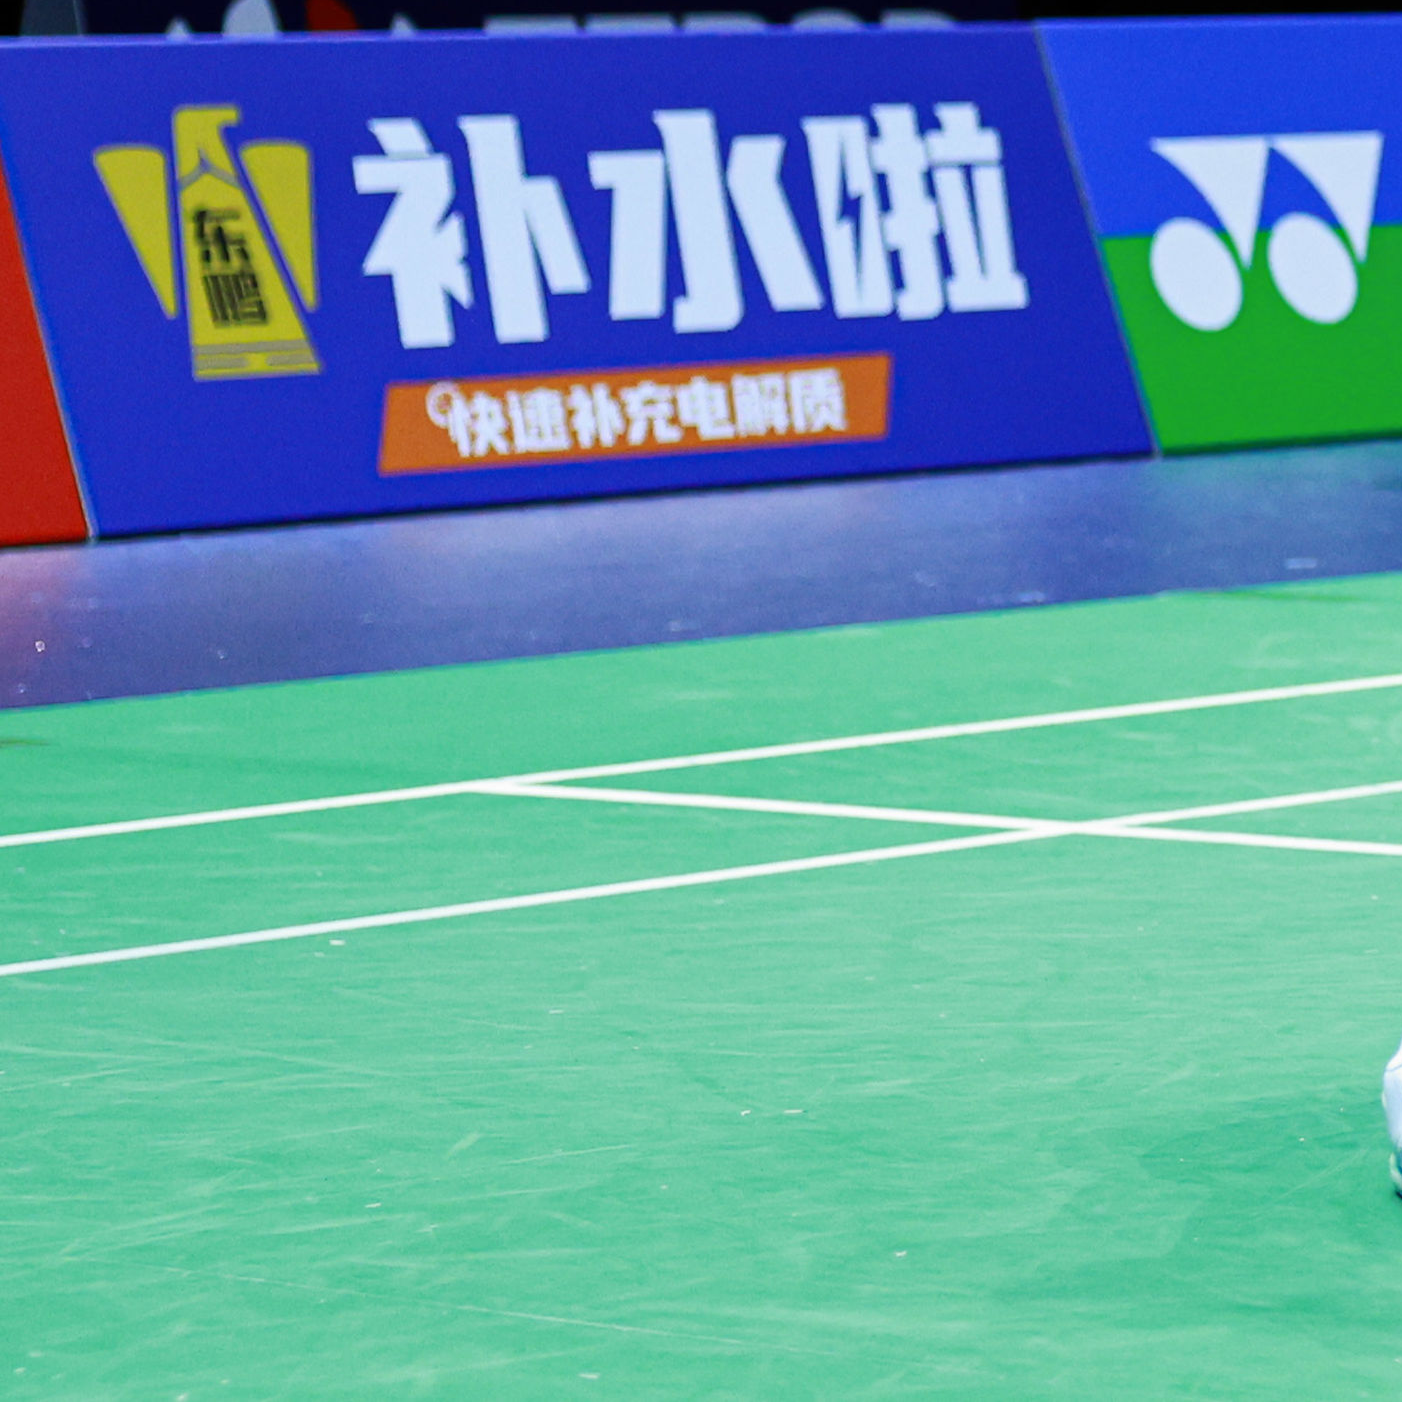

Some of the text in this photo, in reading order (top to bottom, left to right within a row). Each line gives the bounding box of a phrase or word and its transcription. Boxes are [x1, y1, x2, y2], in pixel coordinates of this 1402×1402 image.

[353, 102, 1028, 348] 补水啦
[447, 368, 848, 458] 快速补充电解质
